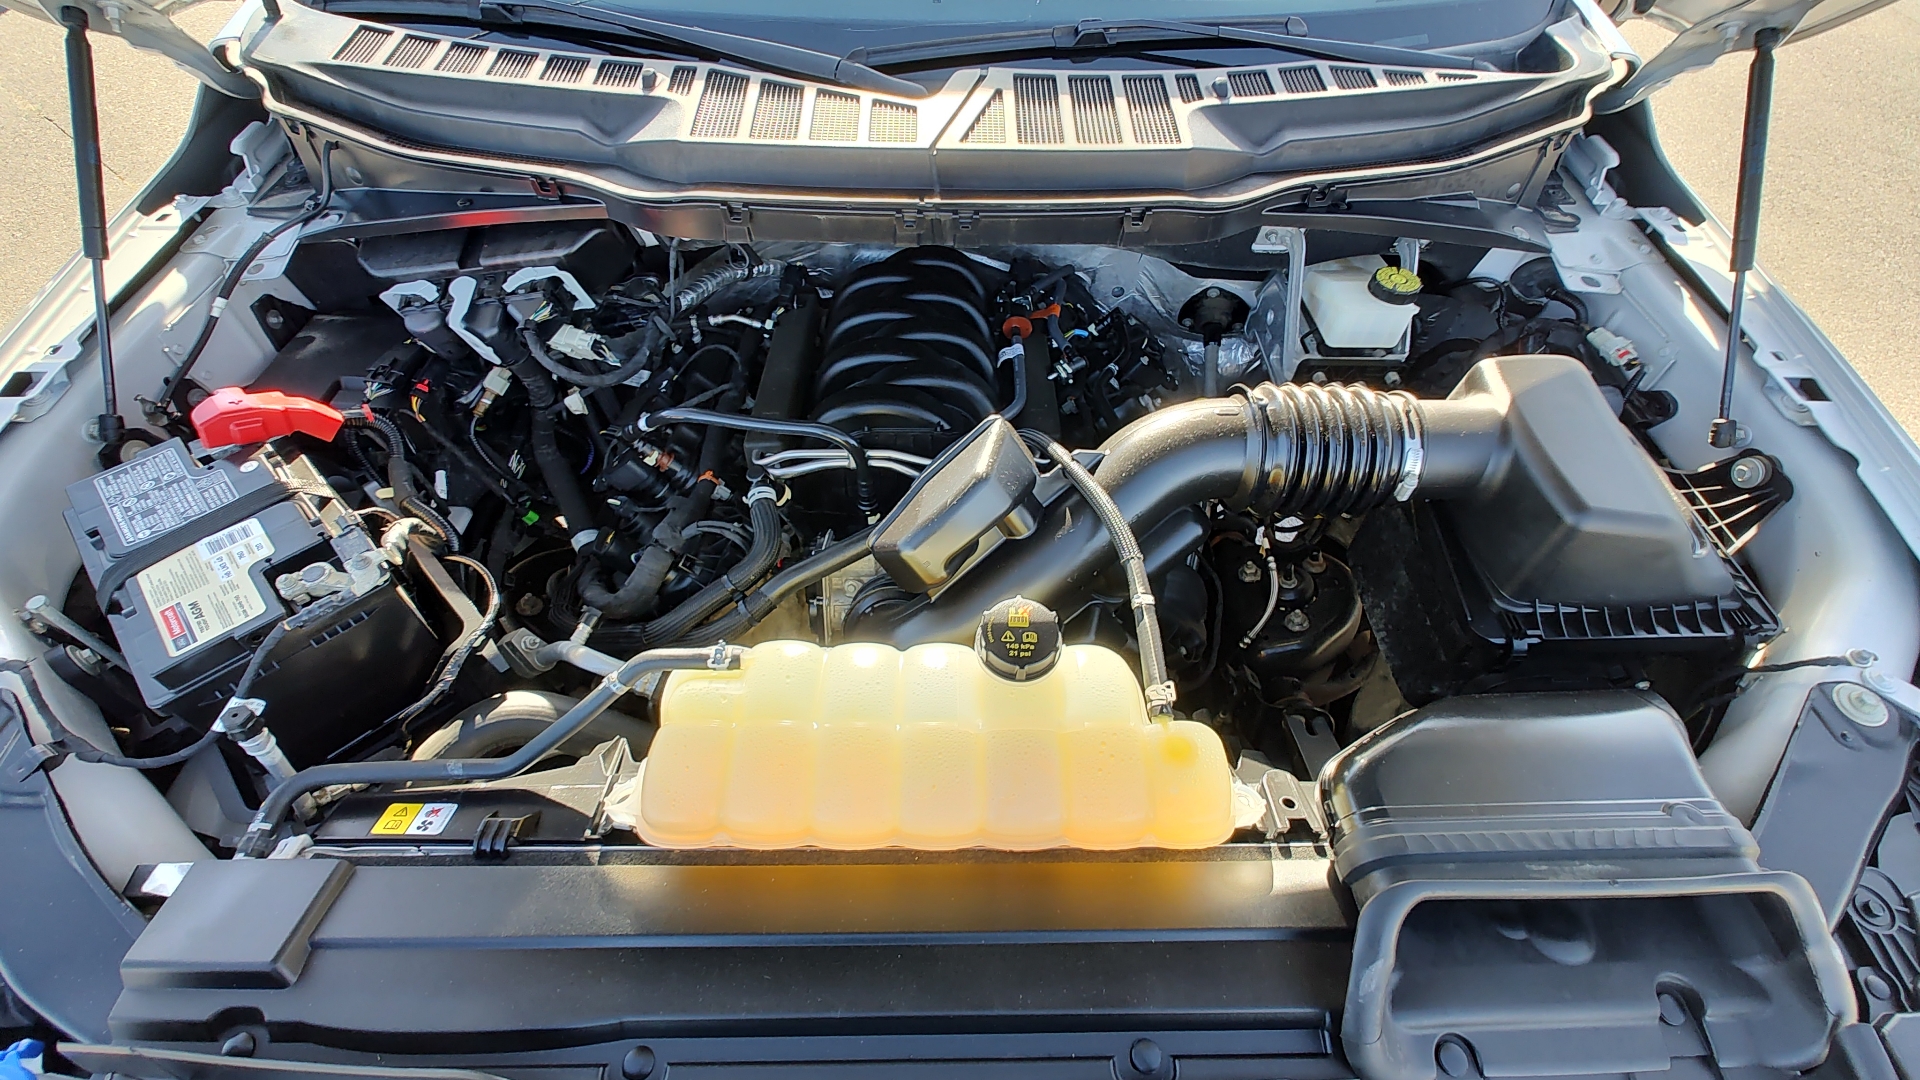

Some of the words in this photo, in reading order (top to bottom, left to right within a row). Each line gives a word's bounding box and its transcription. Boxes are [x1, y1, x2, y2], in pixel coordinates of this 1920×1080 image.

[187, 600, 206, 620] AGM
[163, 608, 182, 636] Motorcraft
[1019, 650, 1032, 658] psi
